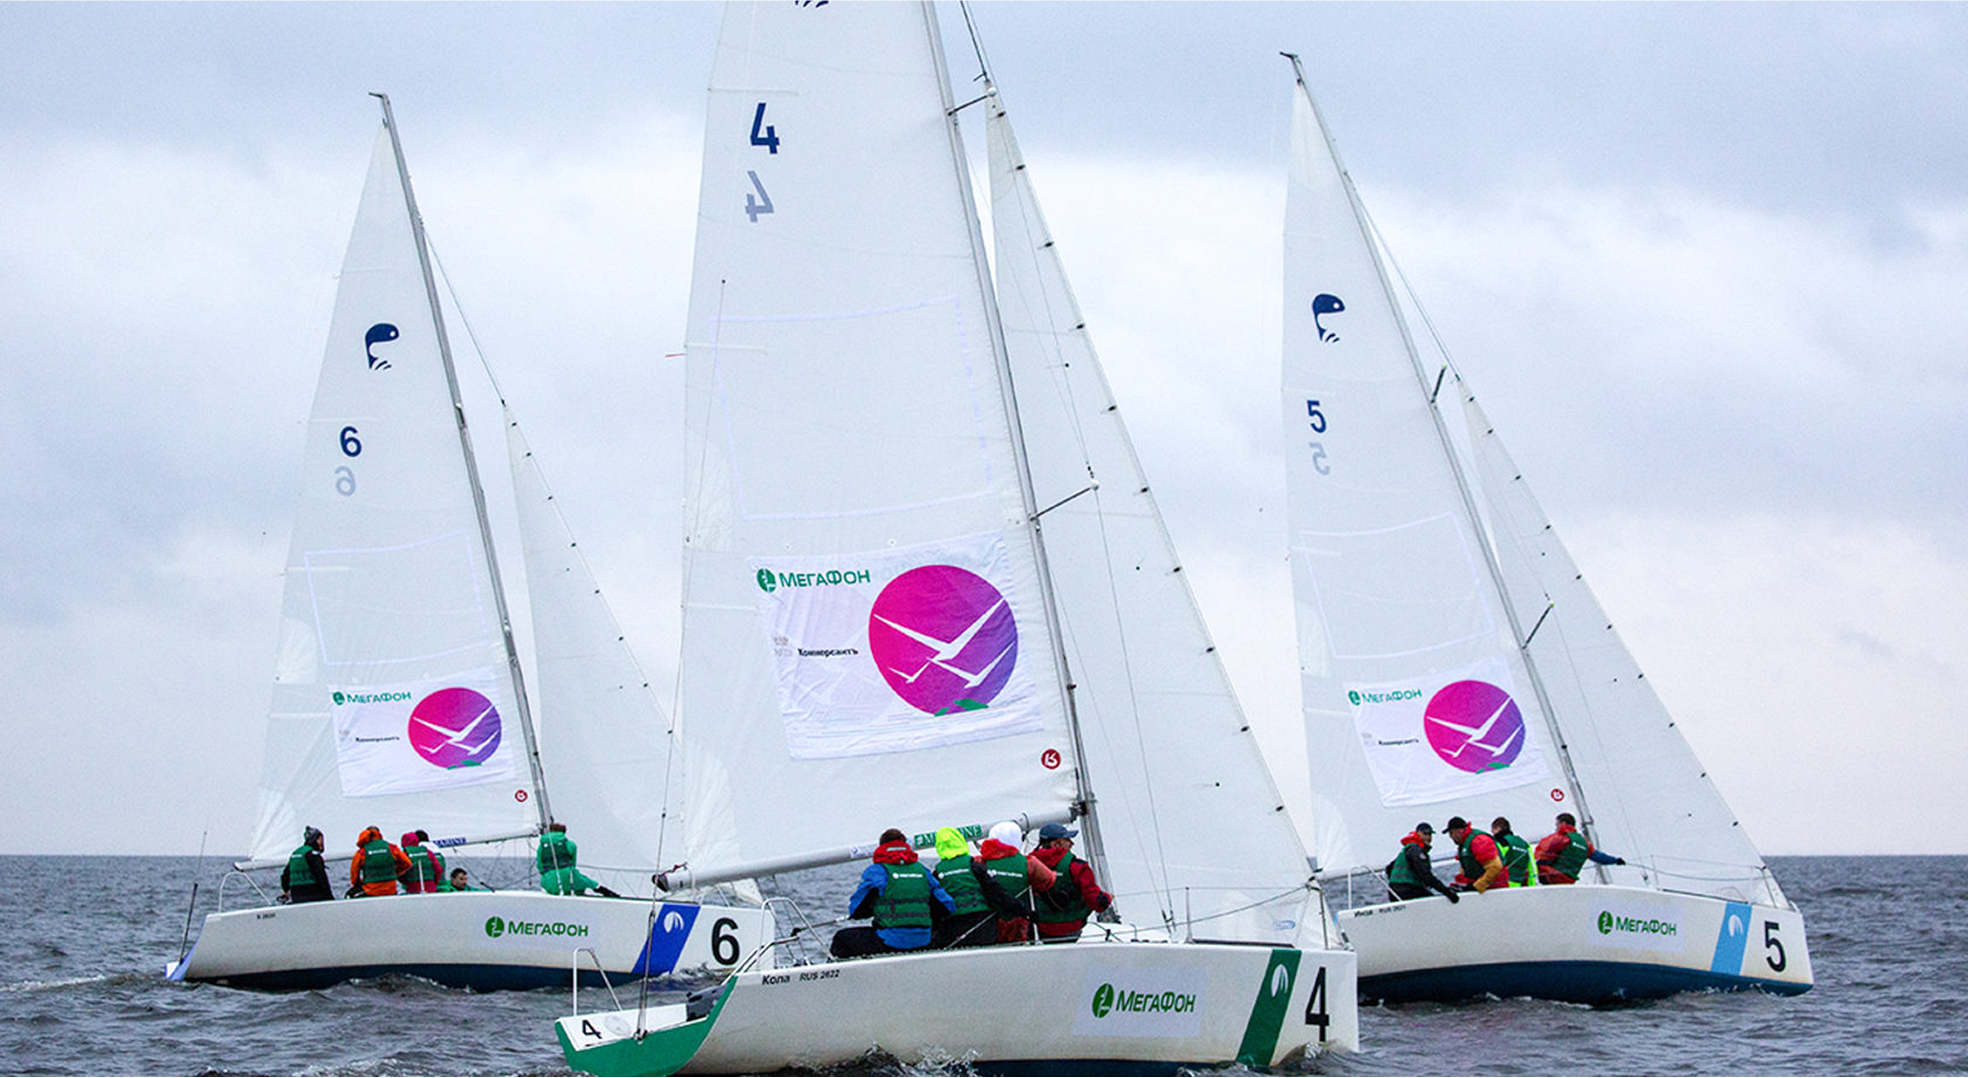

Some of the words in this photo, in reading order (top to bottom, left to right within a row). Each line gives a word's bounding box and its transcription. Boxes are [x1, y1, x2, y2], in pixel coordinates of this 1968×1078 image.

[750, 102, 780, 154] 4
[1306, 399, 1327, 433] 5
[339, 426, 362, 457] 6
[710, 917, 740, 966] 6
[1764, 920, 1787, 973] 5
[1305, 966, 1330, 1042] 4
[581, 1019, 602, 1040] 4
